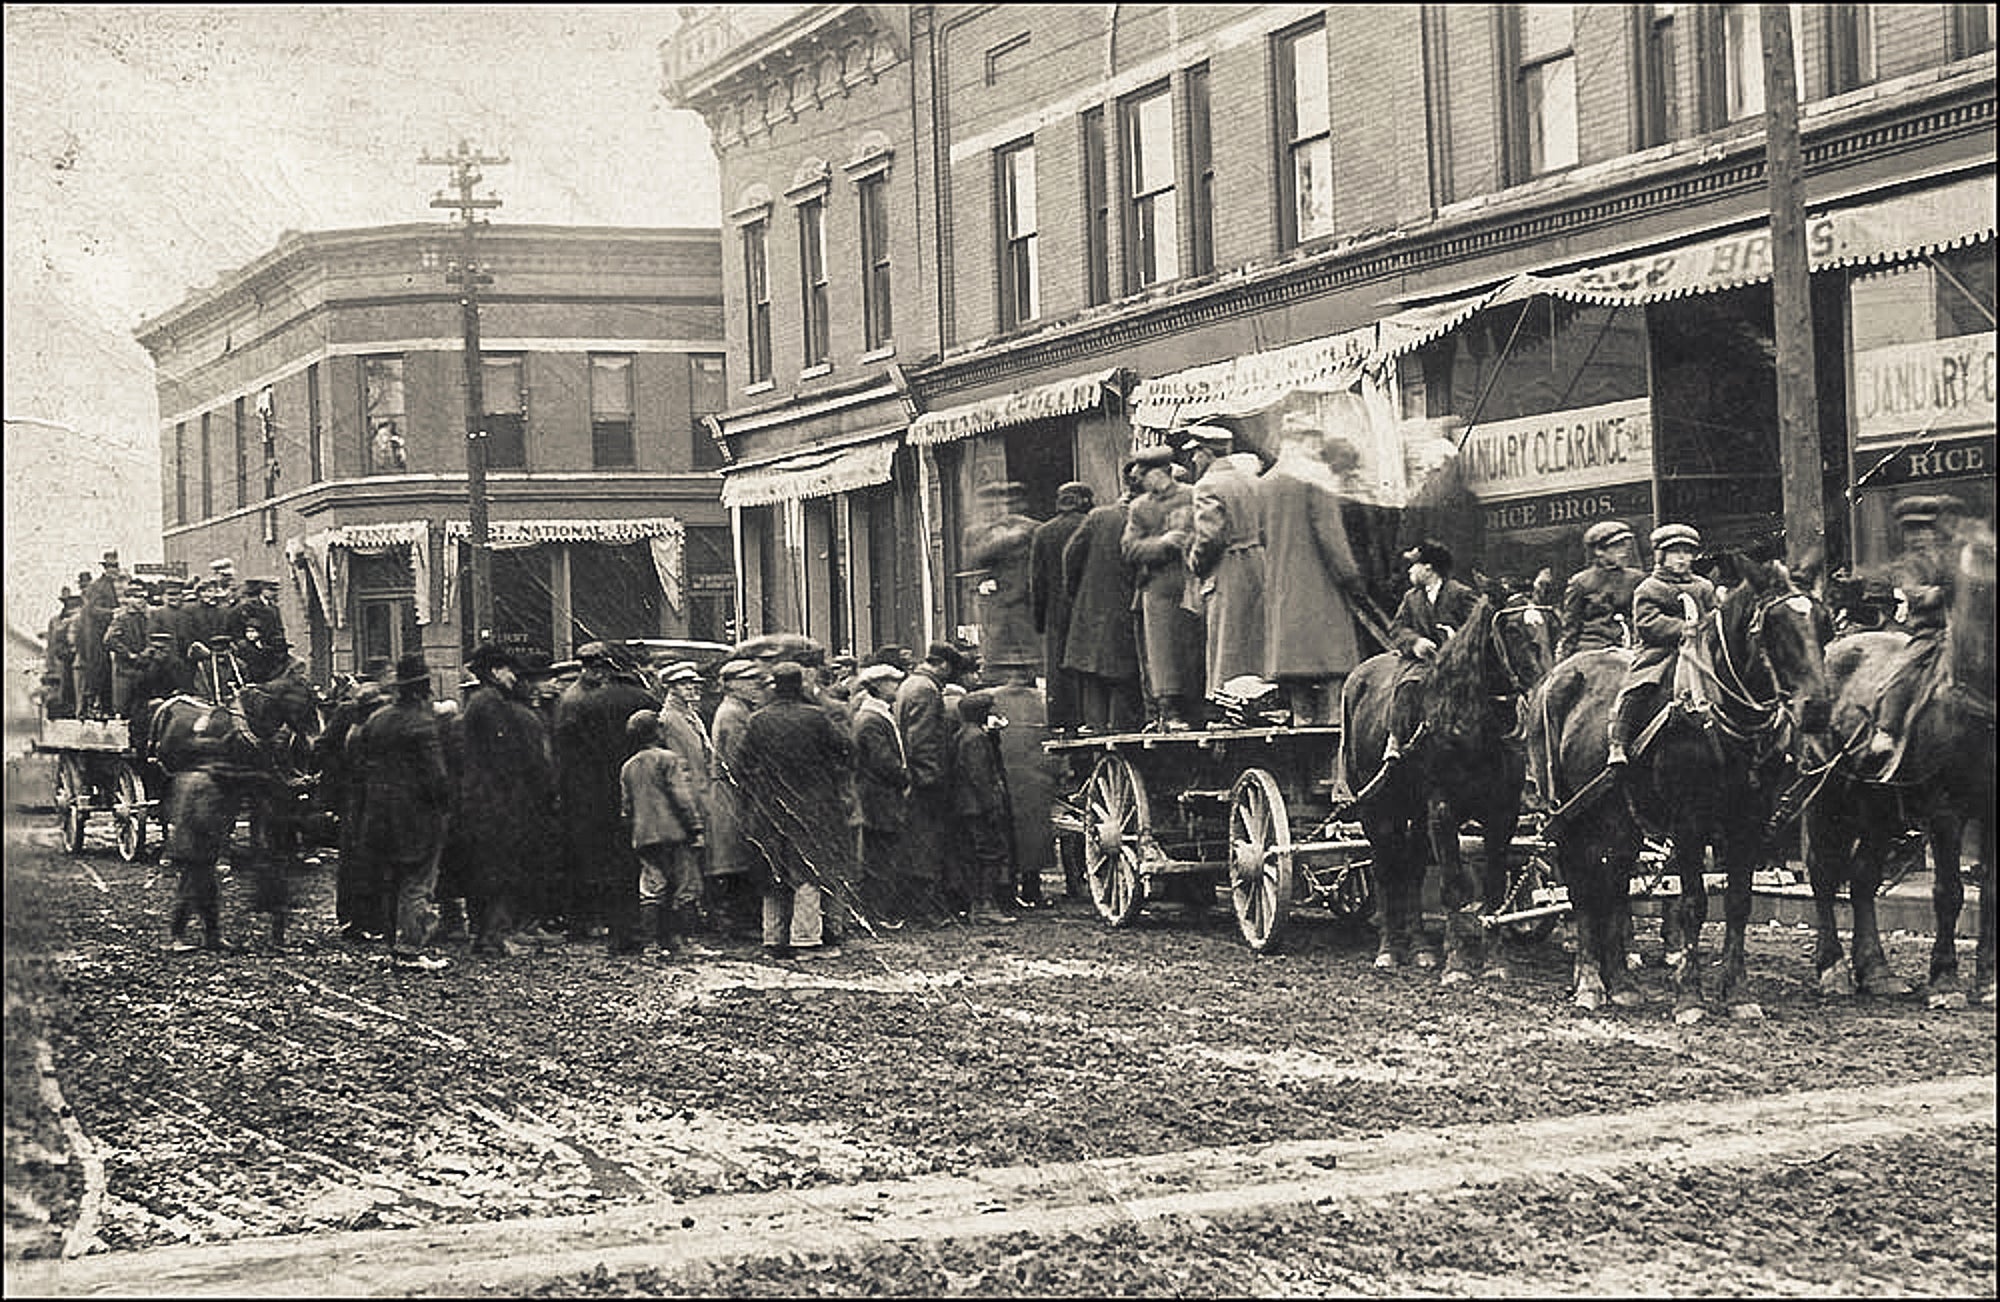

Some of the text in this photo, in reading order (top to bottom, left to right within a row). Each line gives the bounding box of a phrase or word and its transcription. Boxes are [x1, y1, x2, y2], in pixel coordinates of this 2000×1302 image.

[1708, 219, 1847, 276] BRS.
[1534, 417, 1627, 475] CLEARANCE
[1908, 448, 1983, 478] RICE
[1550, 495, 1616, 522] BROS.
[519, 523, 604, 536] NATIONAL
